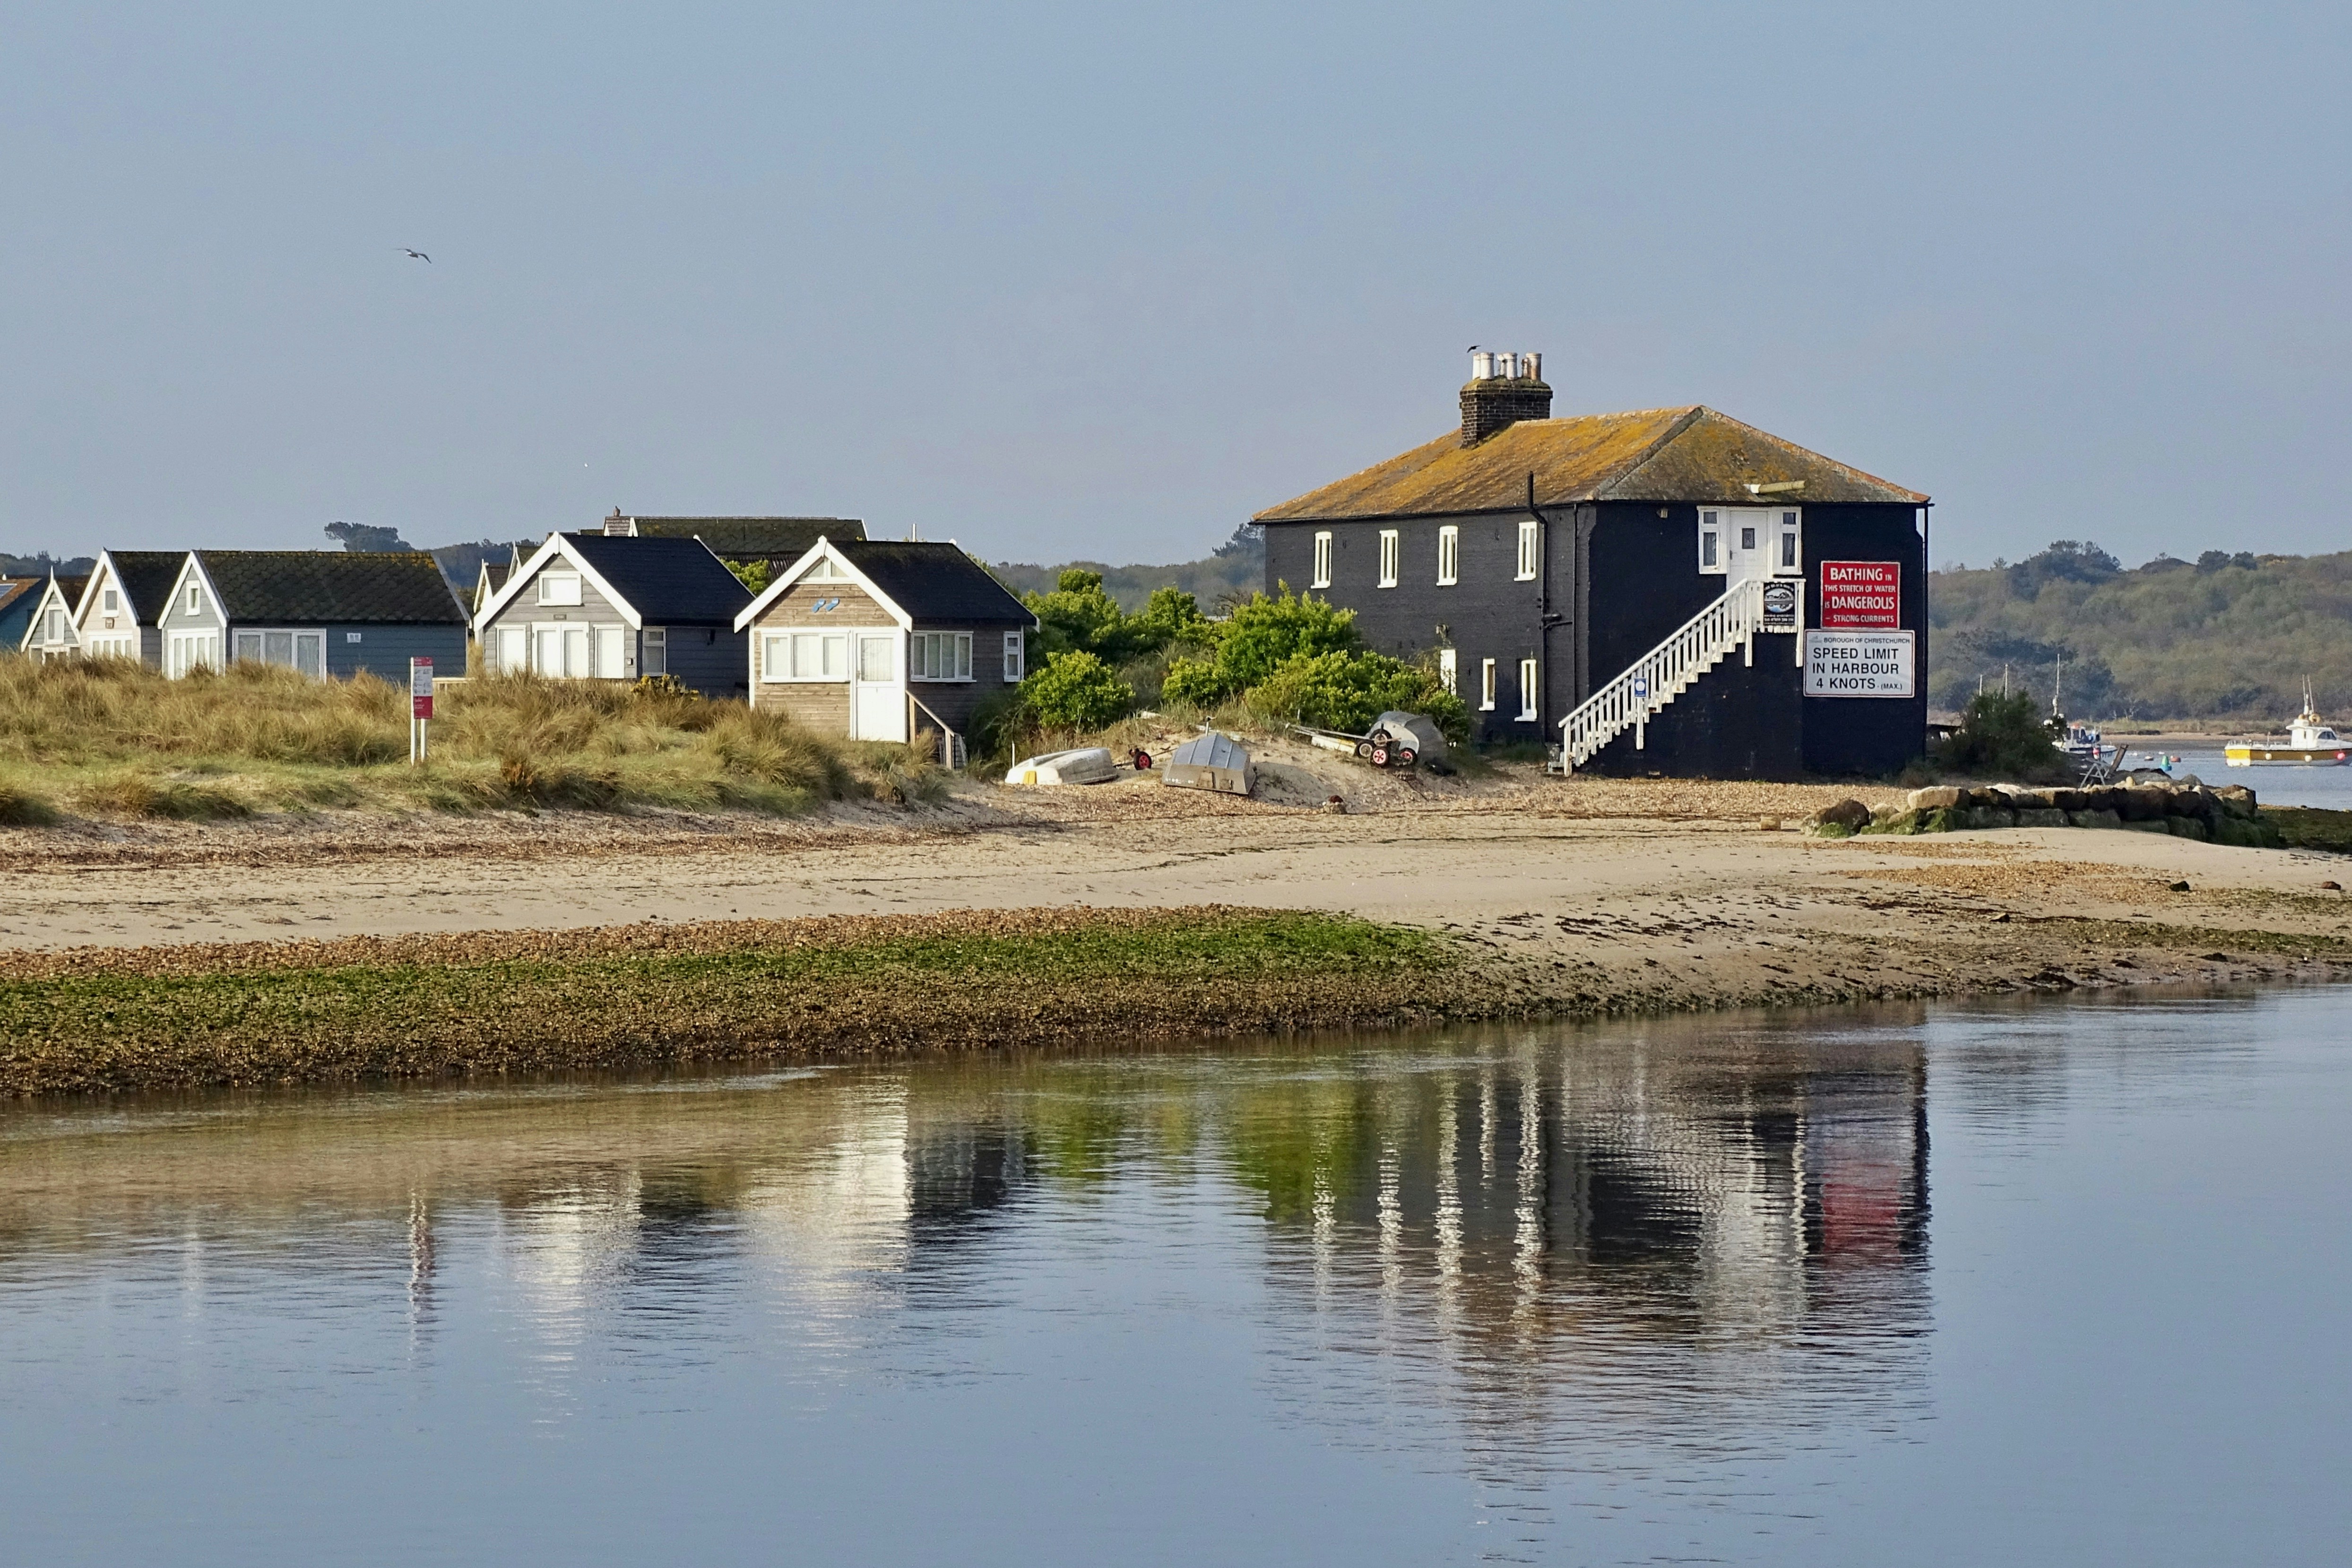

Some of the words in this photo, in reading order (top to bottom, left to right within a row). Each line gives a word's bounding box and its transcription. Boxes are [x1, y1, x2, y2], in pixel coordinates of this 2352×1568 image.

[1830, 568, 1883, 581] BATHING
[1832, 596, 1894, 609] DANGEROUS
[1813, 648, 1858, 659] SPEED
[1865, 648, 1899, 659] LIMIT
[1813, 663, 1825, 674] IN
[1832, 663, 1899, 674] HARBOUR
[1816, 678, 1824, 688] 4
[1830, 678, 1876, 689] KNOTS
